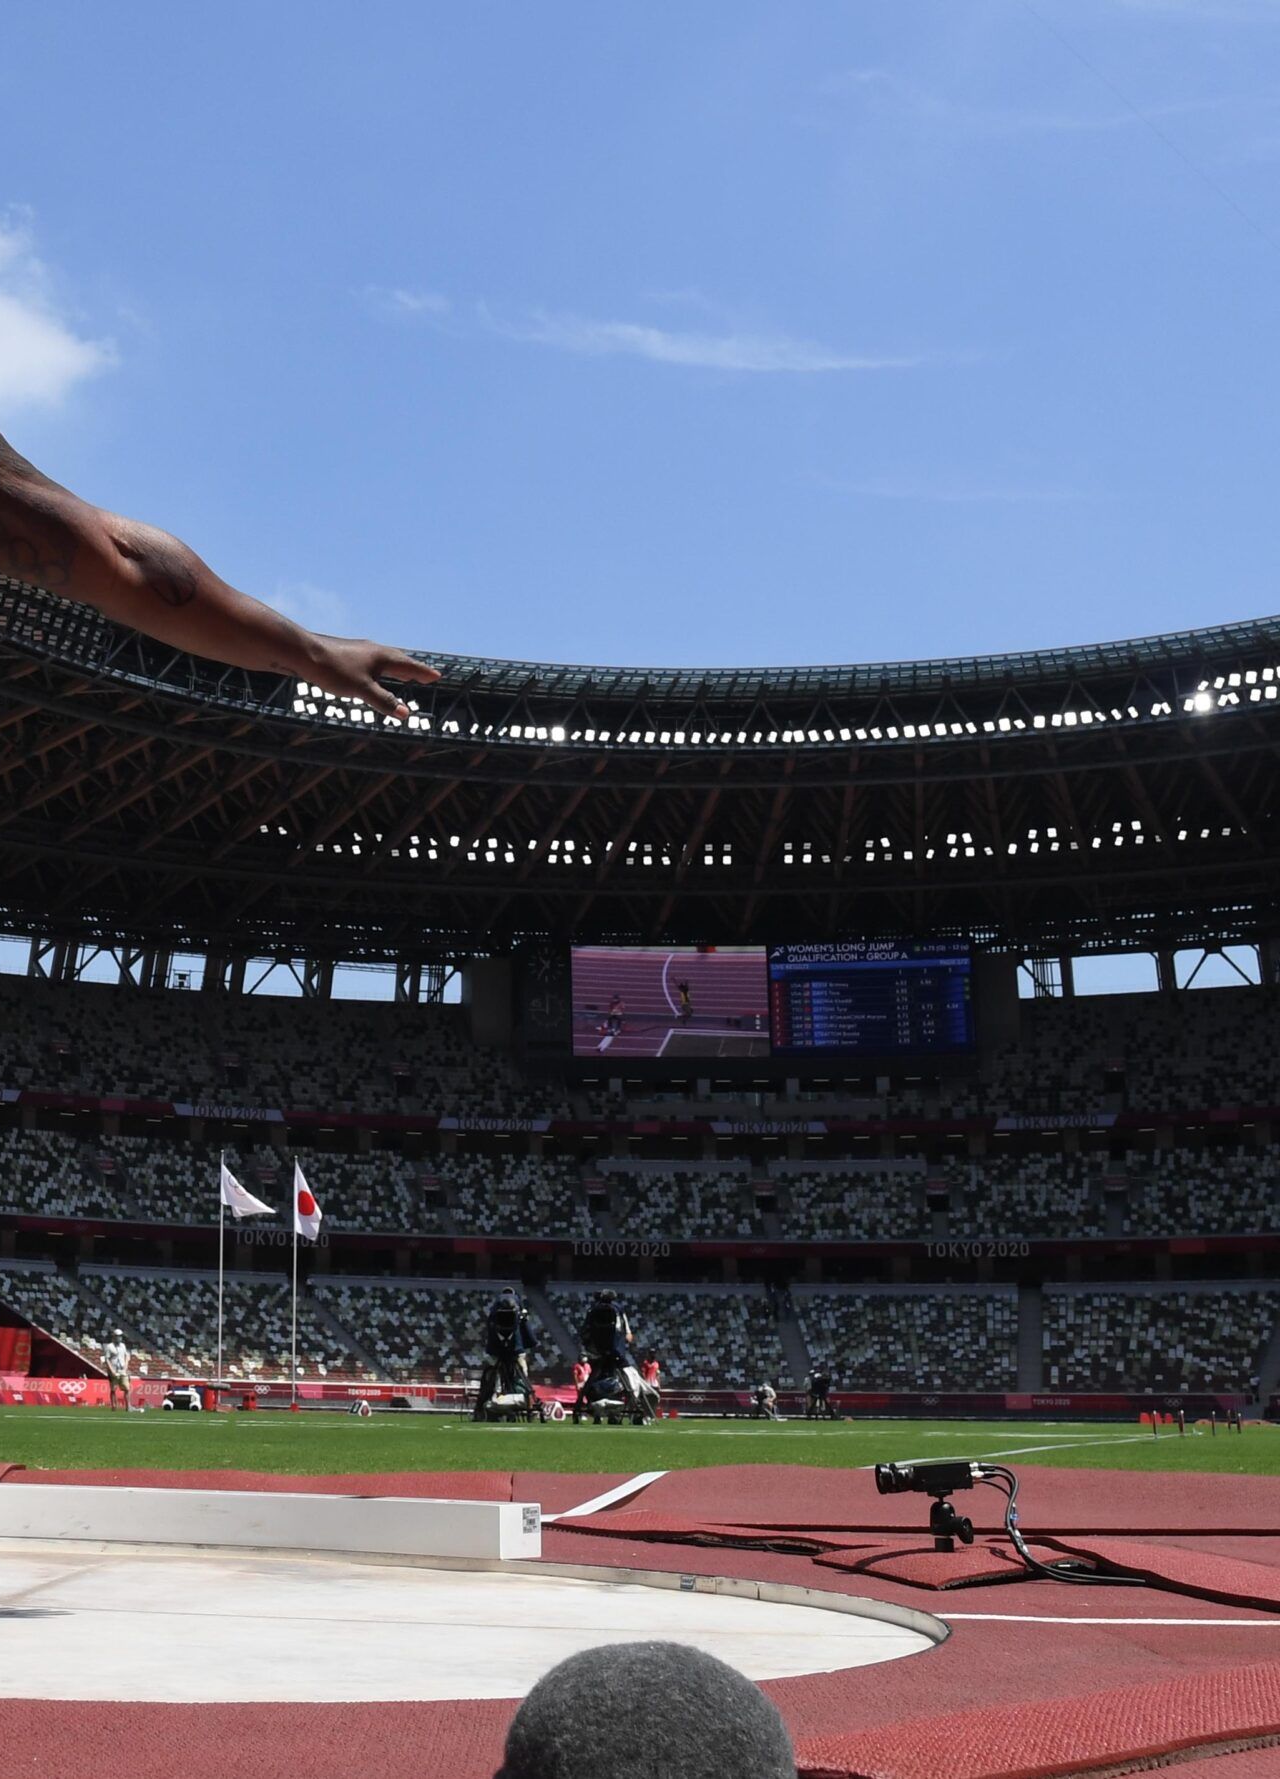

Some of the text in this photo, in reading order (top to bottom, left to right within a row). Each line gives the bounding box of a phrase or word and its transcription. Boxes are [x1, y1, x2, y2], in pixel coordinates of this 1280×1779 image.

[787, 942, 894, 954] WOMEN'S LONG JUMP
[787, 953, 858, 963] QUALIFICATION
[866, 952, 898, 961] GROUP
[900, 952, 908, 960] A
[192, 1103, 266, 1120] TOKYO 2020
[456, 1118, 533, 1132] TOKYO 2020
[729, 1121, 773, 1134] TOKYO
[1062, 1114, 1098, 1128] 2020
[236, 1229, 286, 1247] TOKYO
[571, 1240, 671, 1258] TOKYO 2020
[924, 1241, 1030, 1258] TOKYO 2020
